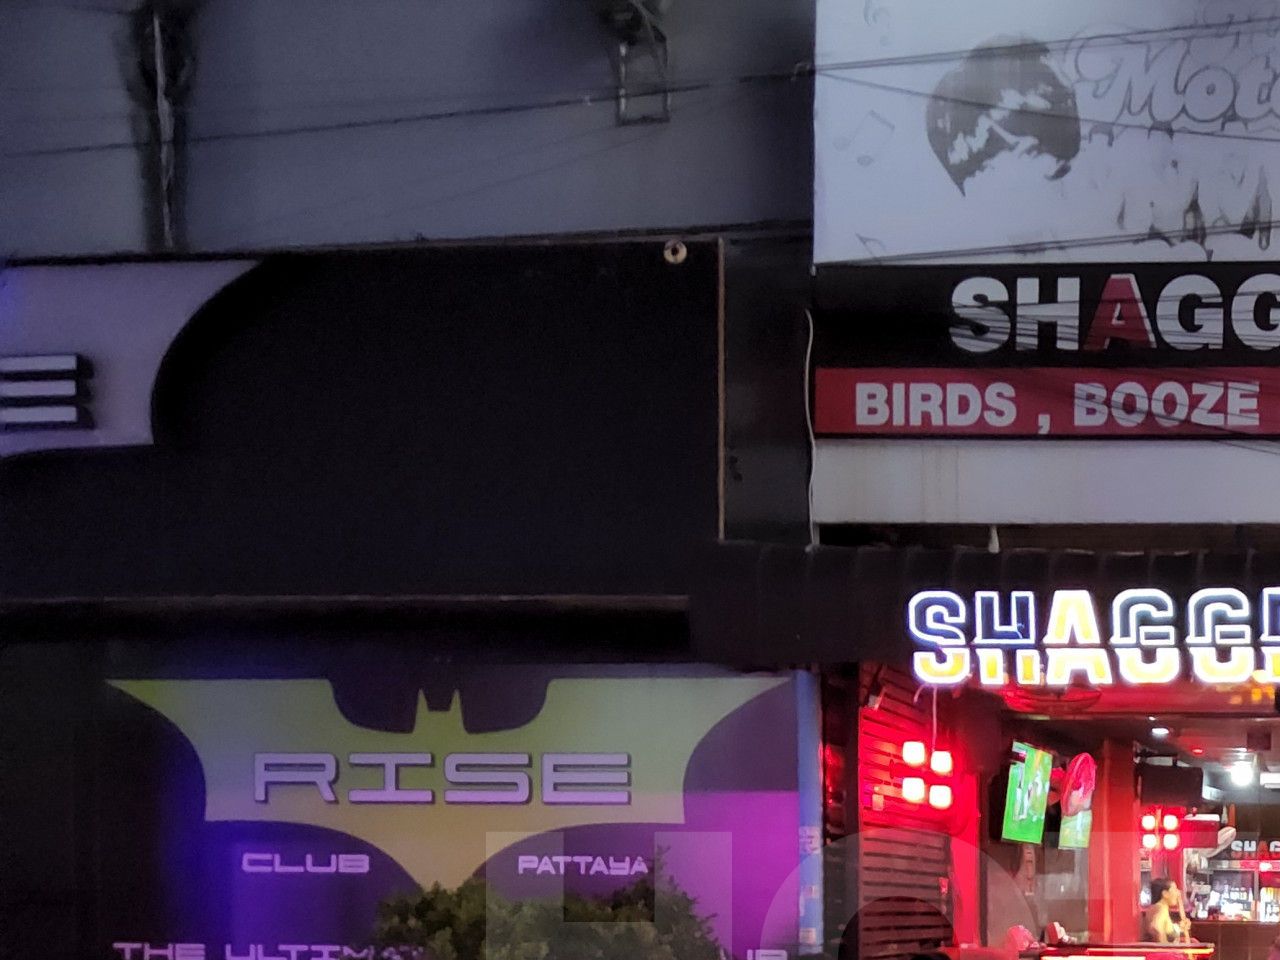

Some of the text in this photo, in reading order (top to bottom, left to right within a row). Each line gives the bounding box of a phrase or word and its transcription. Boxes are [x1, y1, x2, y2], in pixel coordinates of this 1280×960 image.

[854, 380, 1017, 428] BIRDS
[1073, 379, 1260, 429] BOOZE
[253, 752, 633, 804] RISE
[241, 853, 371, 874] CLUB
[517, 853, 649, 876] PATTAYA
